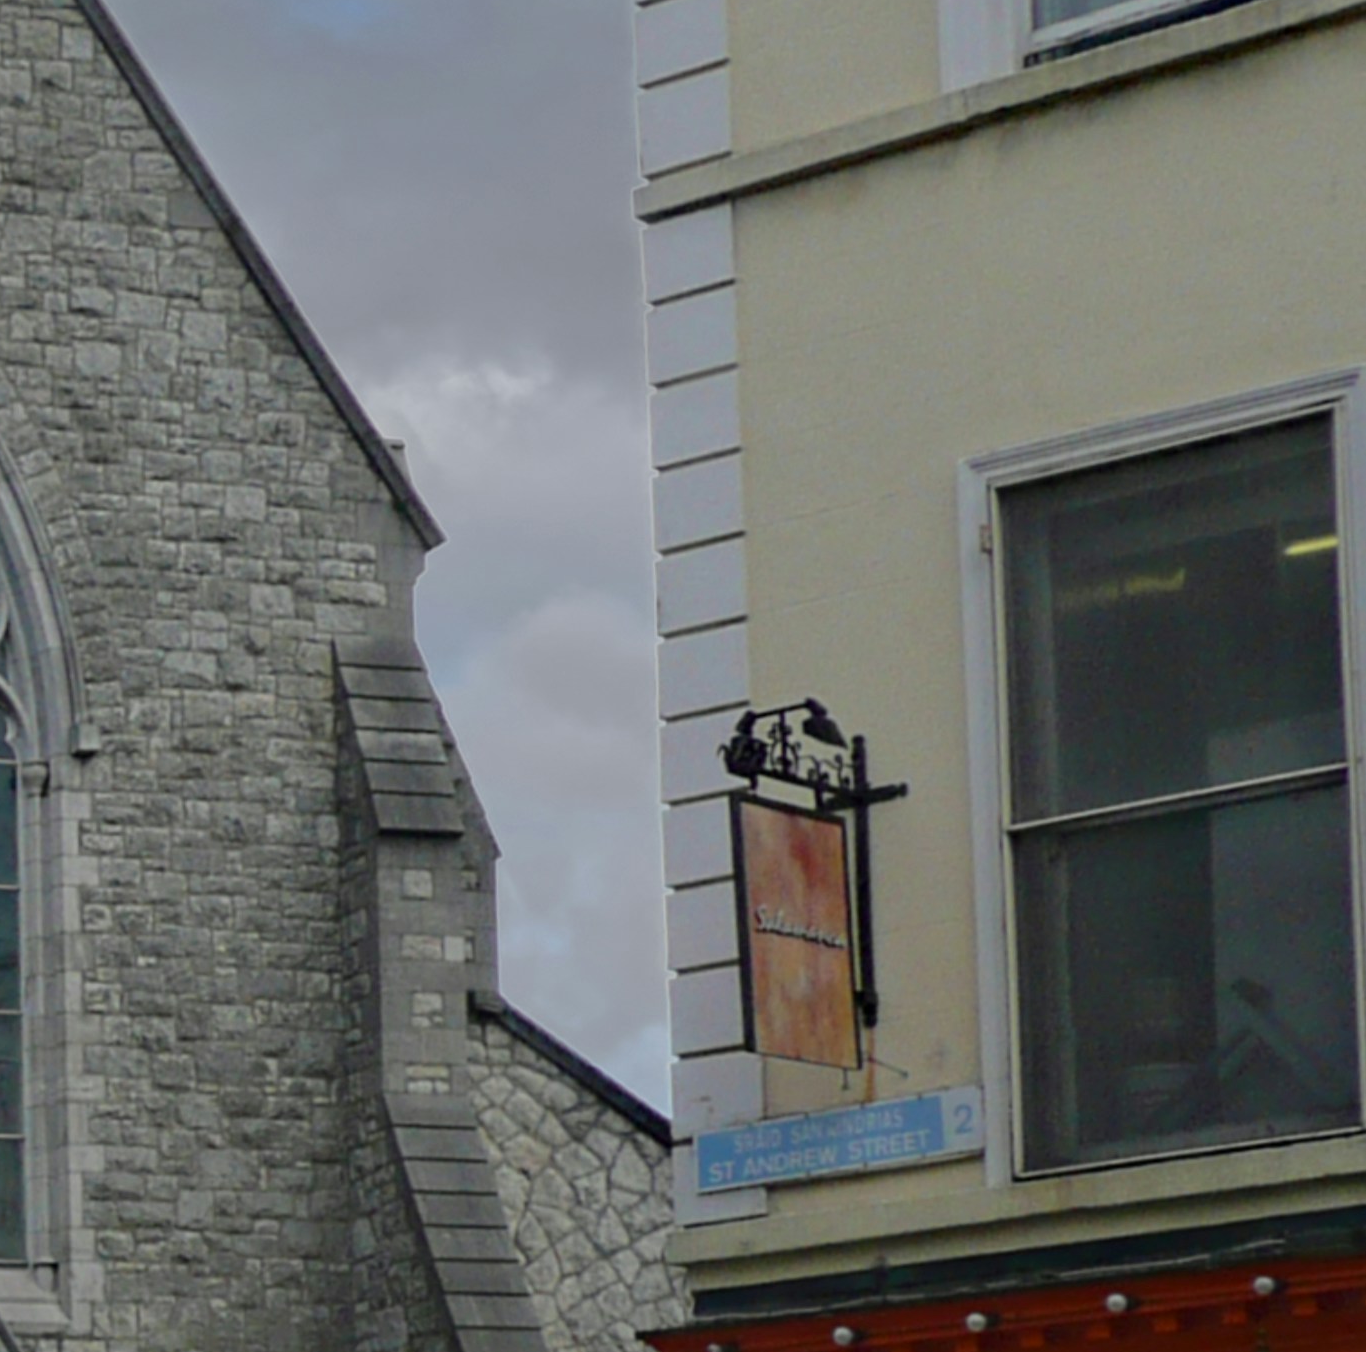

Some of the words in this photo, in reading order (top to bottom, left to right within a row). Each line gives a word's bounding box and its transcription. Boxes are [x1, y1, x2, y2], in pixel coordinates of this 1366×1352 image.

[953, 1104, 973, 1135] 2
[709, 1162, 734, 1183] ST
[743, 1146, 838, 1178] ANDREW
[849, 1130, 930, 1160] STREET
